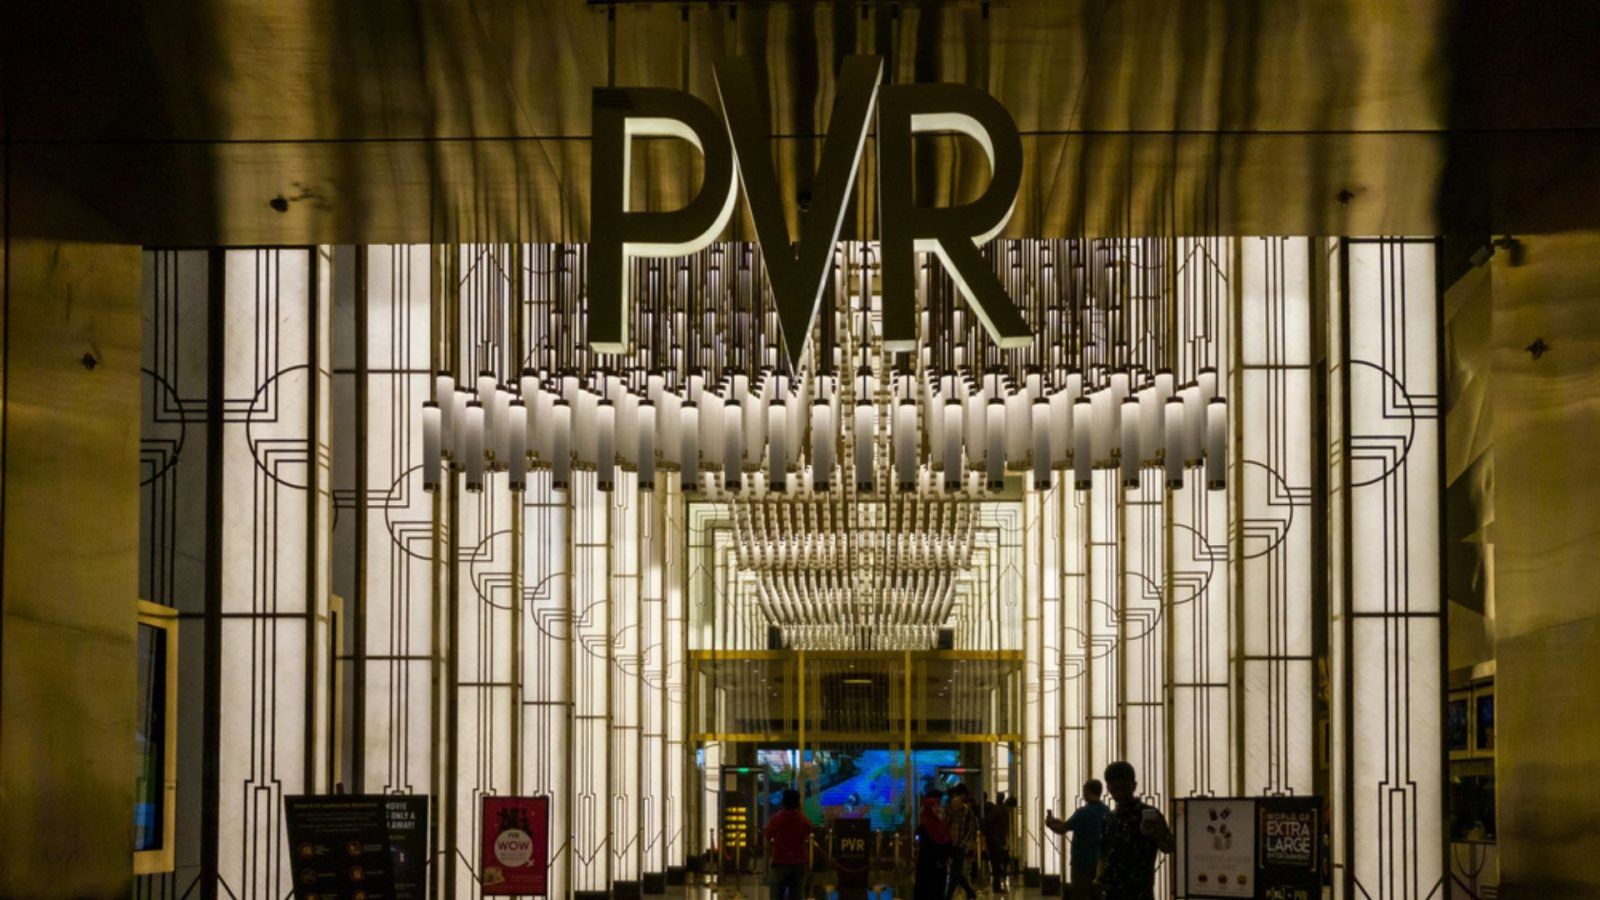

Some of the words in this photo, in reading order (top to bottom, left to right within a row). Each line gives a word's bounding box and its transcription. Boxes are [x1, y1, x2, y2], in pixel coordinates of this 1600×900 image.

[588, 54, 1033, 379] PVR
[1266, 820, 1310, 836] EXTRA
[497, 841, 530, 851] WOW
[841, 837, 865, 852] PVR
[1266, 836, 1311, 853] LARGE
